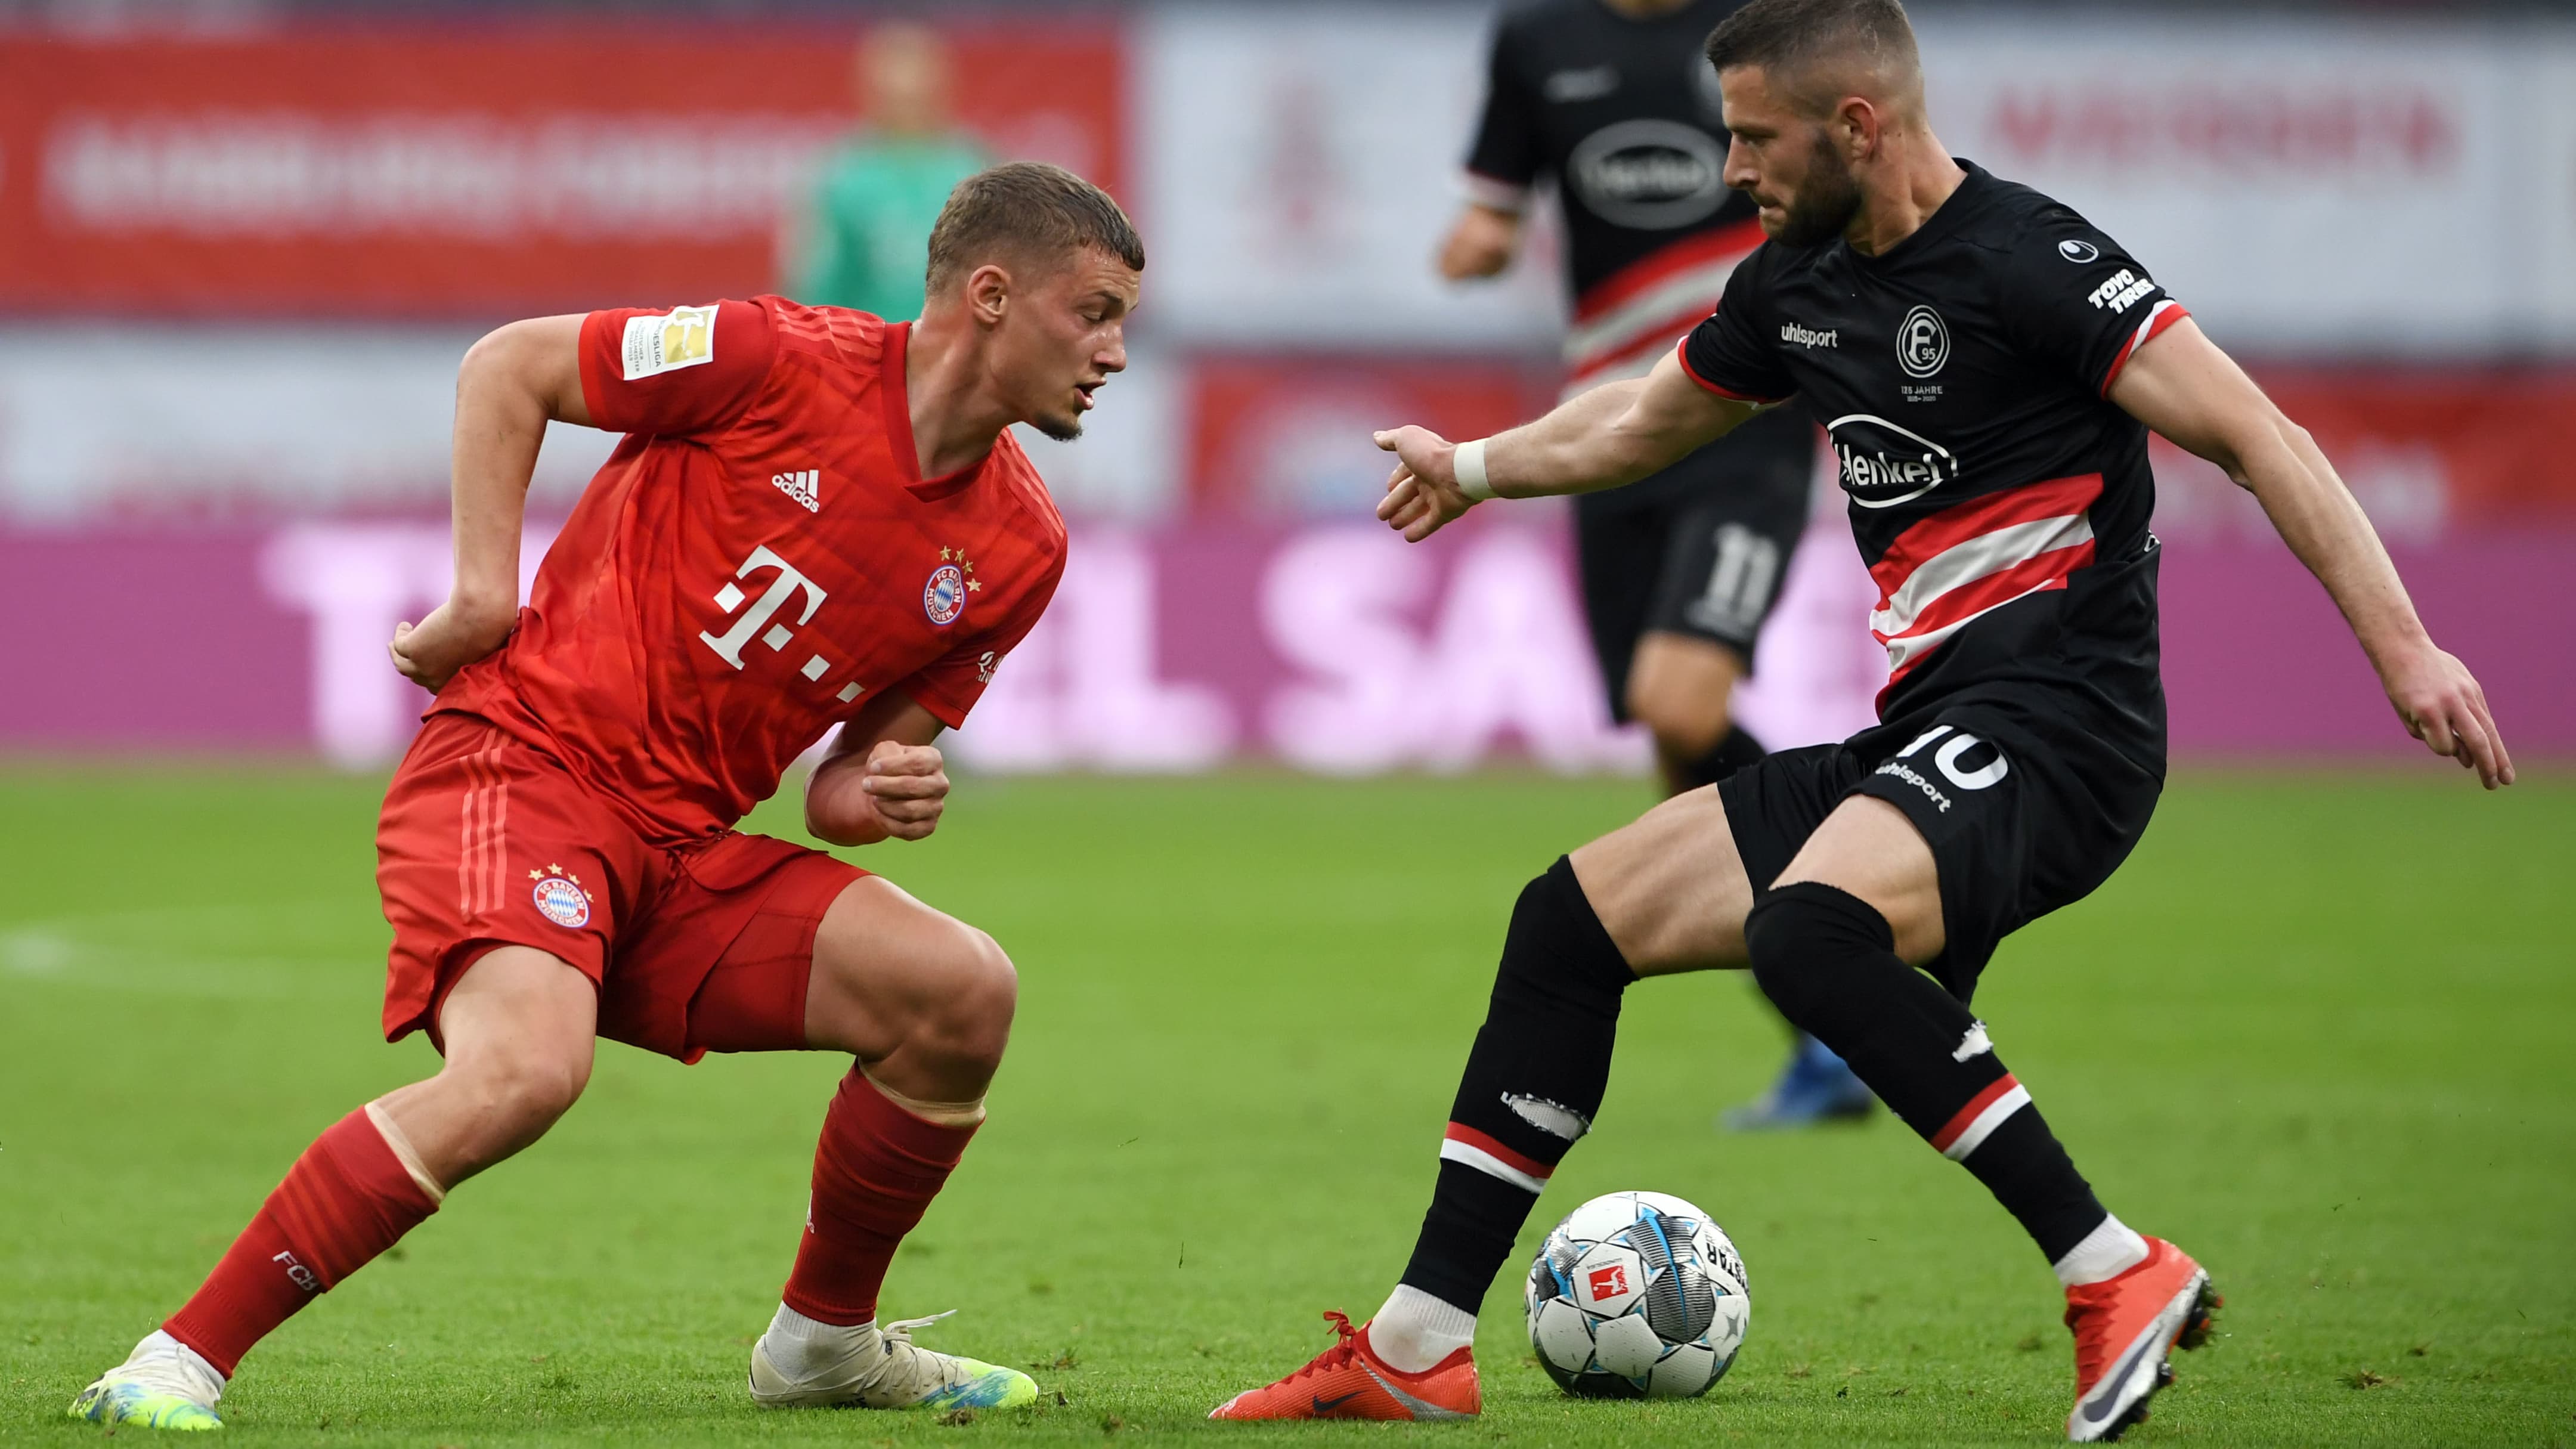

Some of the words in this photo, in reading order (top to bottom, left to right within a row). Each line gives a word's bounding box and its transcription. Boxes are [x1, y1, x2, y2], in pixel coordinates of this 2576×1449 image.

[2088, 269, 2135, 309] TOYO
[2108, 278, 2156, 314] TIRES
[1781, 322, 1837, 349] uhlsport
[1922, 348, 1936, 360] 95
[1914, 386, 1943, 394] JAHRE
[772, 475, 820, 513] adidas
[936, 570, 948, 581] FC
[1684, 522, 1778, 642] 11
[1896, 724, 2008, 790] 10
[1875, 762, 1951, 813] uhlsport
[539, 884, 552, 894] FC
[552, 883, 585, 909] BAYERN
